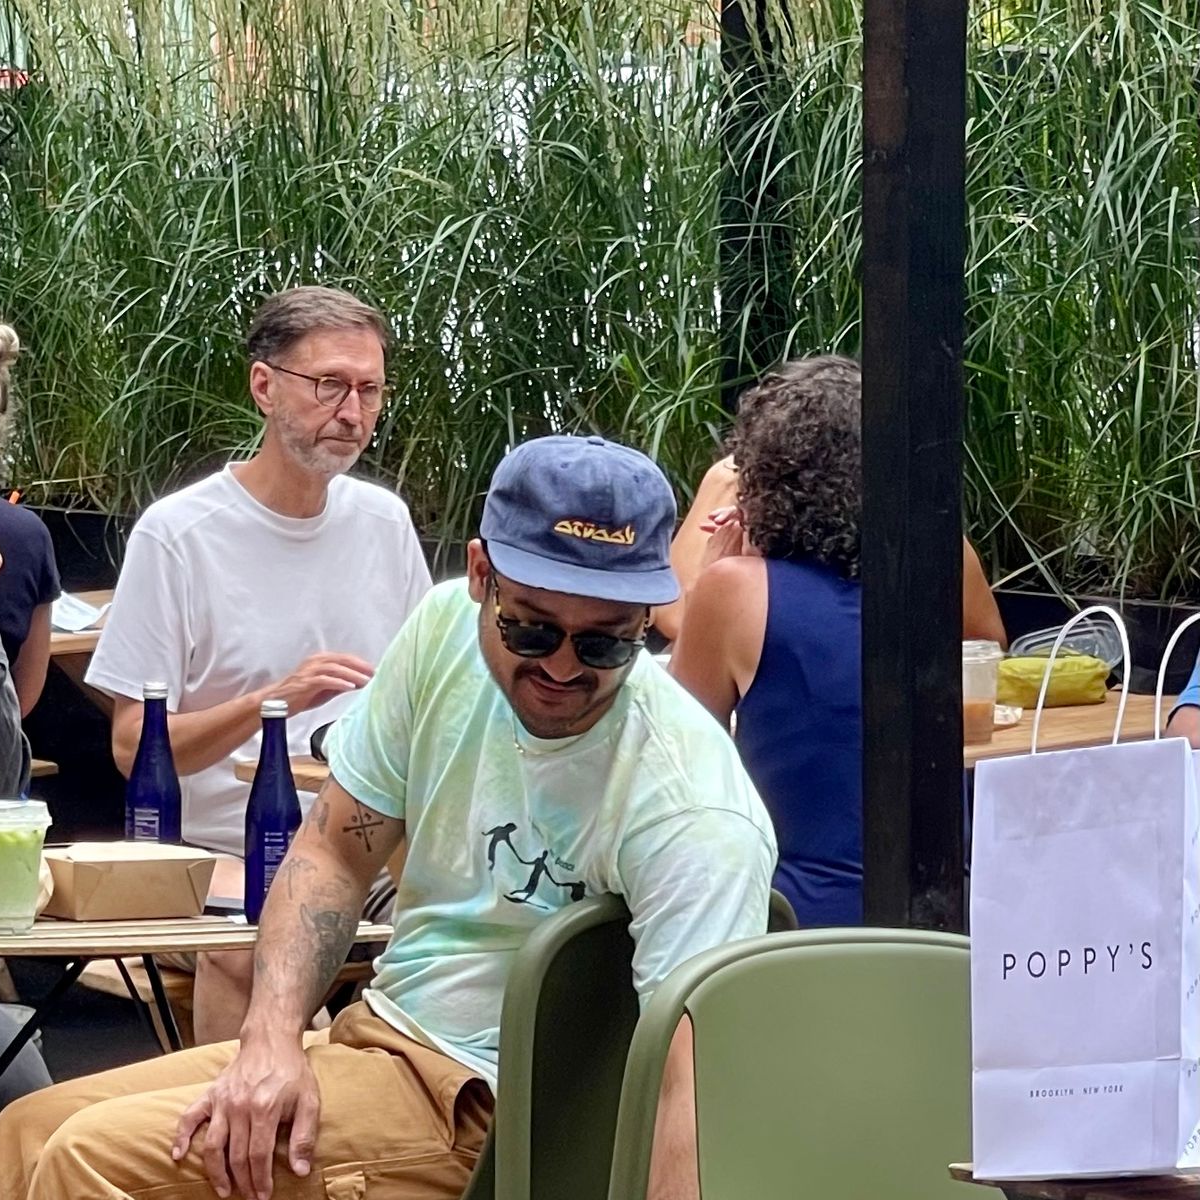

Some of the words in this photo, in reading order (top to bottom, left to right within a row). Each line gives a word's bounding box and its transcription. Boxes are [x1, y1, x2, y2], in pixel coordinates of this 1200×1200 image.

[1003, 942, 1153, 980] POPPY'S
[1030, 1088, 1074, 1098] BROOKLYN
[1083, 1087, 1099, 1095] NEW
[1103, 1084, 1123, 1094] YORK
